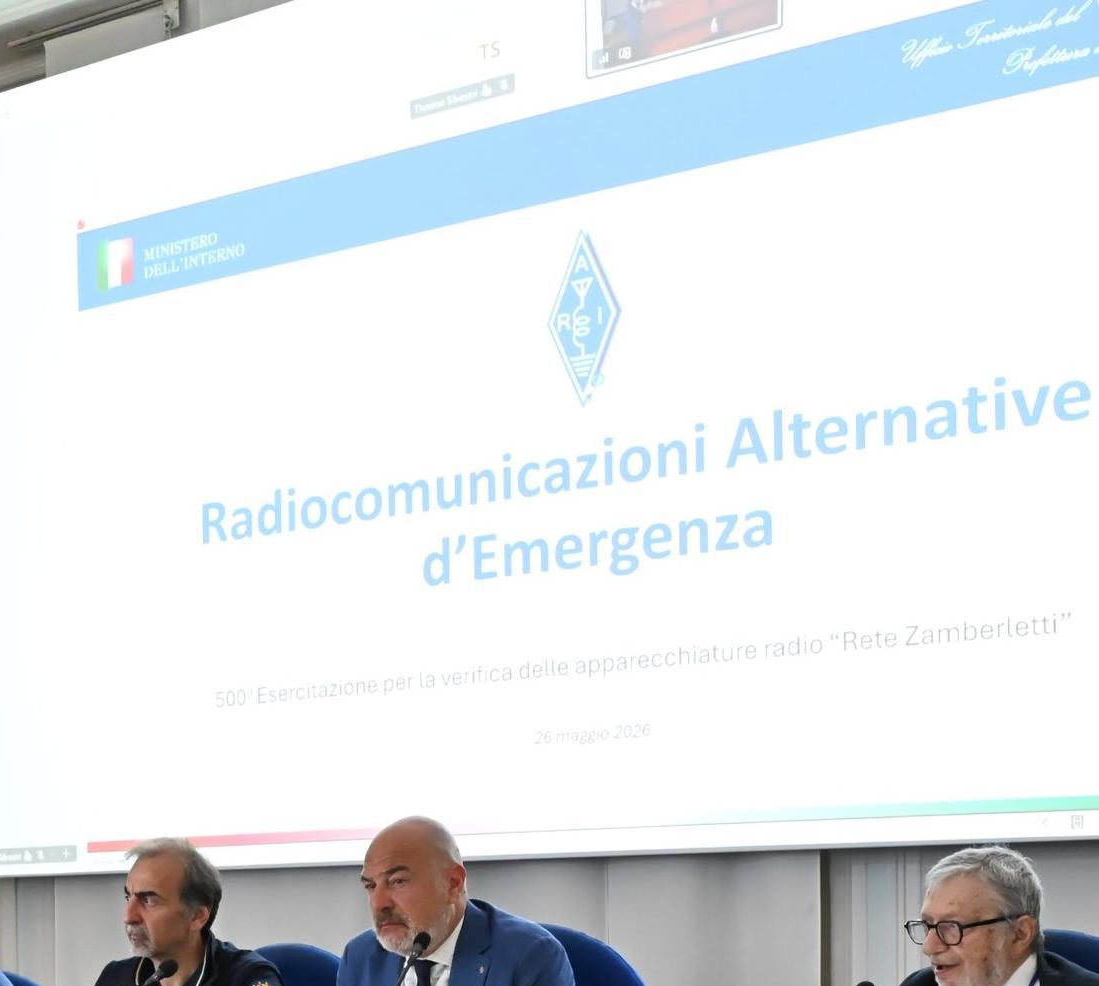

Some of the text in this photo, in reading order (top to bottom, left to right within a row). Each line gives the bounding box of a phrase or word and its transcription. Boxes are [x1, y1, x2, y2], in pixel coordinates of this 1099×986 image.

[957, 7, 1058, 50] Territoriale
[478, 40, 500, 60] TS
[1001, 44, 1091, 77] Prefettura
[143, 231, 218, 262] MINISTERO
[143, 243, 245, 280] DELL'INTERNO
[202, 377, 1093, 544] Radiocomunicazioni Alternative
[423, 509, 774, 587] d’Emergenza
[257, 680, 378, 704] Esercitazione
[383, 675, 414, 697] per
[419, 671, 436, 689] la
[441, 665, 513, 688] verifica
[518, 659, 569, 680] delle
[575, 644, 758, 679] apparecchiature
[764, 636, 823, 658] radio
[534, 723, 651, 746] 26 maggio 2026
